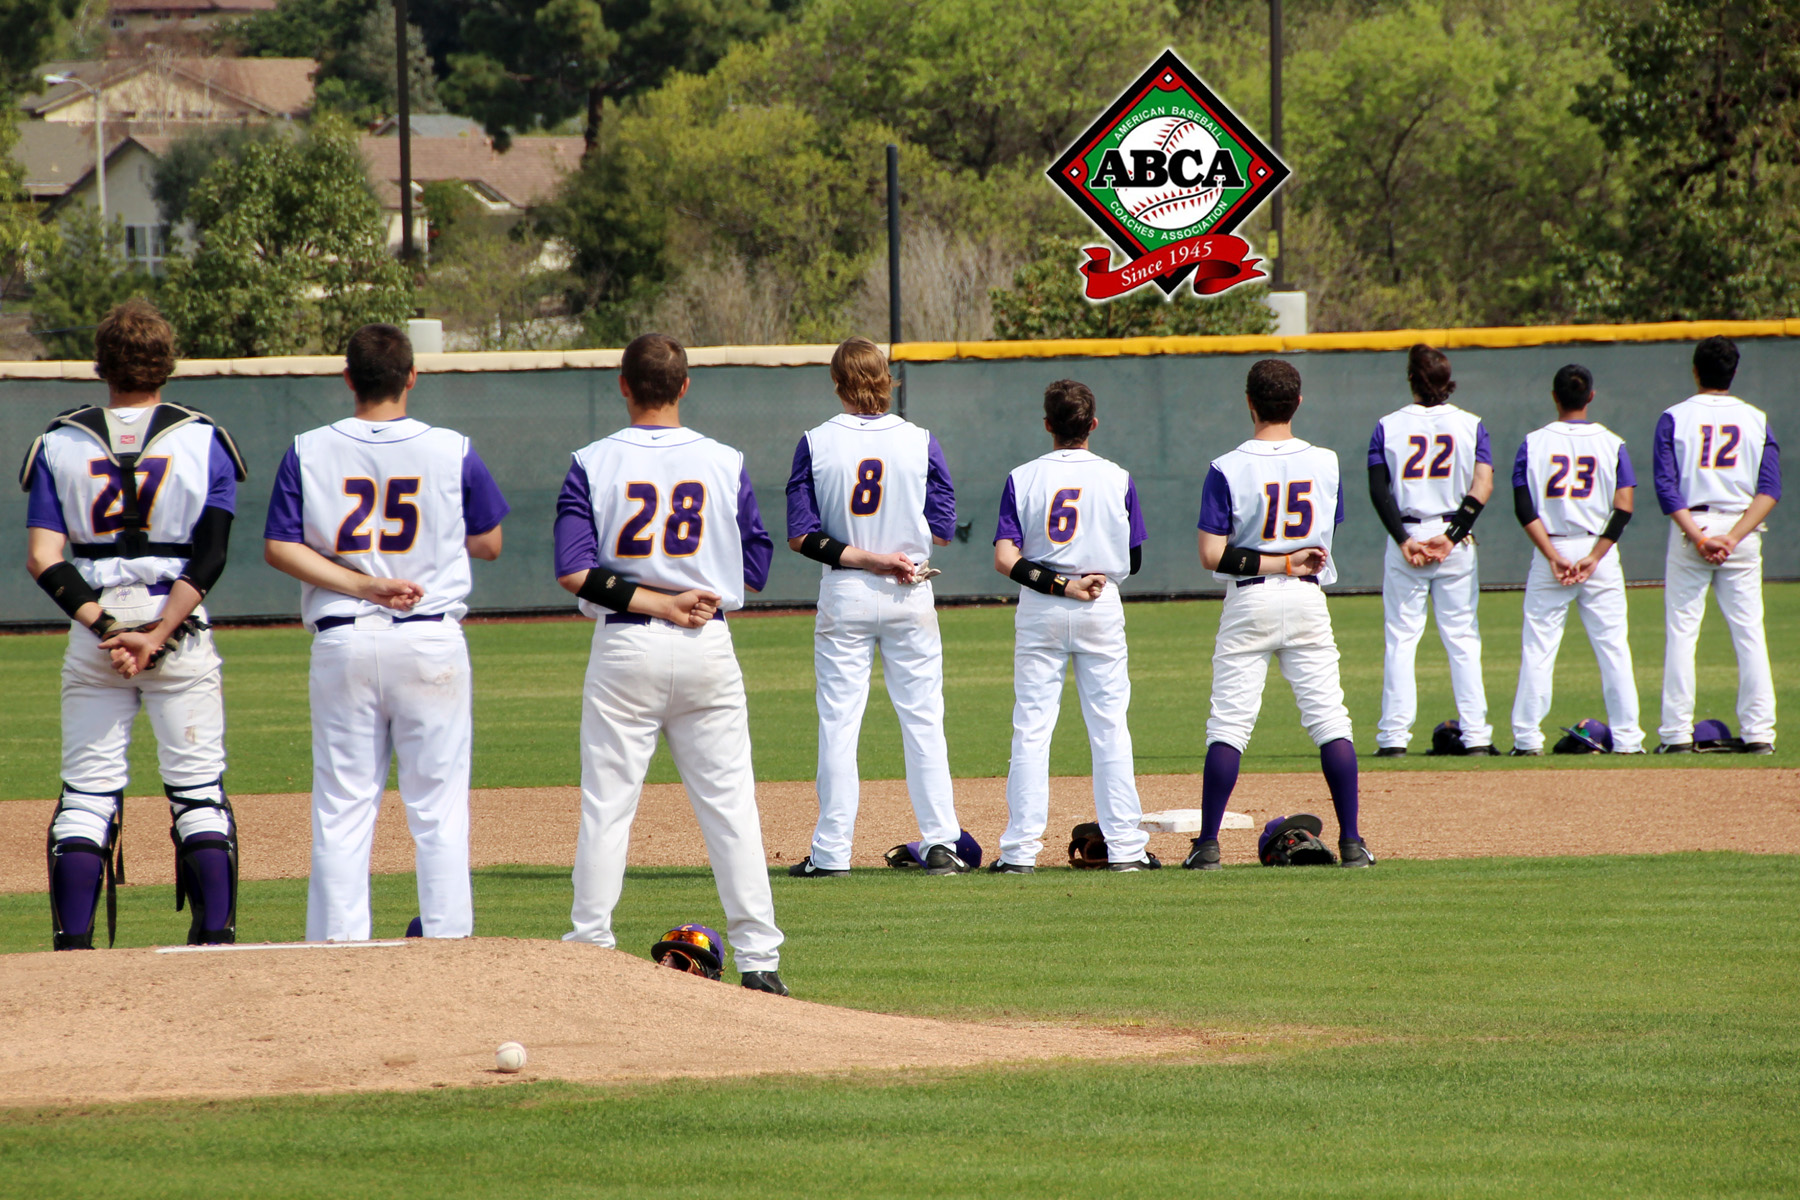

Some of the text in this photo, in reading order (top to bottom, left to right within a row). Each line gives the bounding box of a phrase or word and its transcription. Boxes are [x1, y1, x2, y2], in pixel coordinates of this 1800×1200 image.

[1402, 434, 1454, 480] 22
[1546, 454, 1596, 499] 23
[1699, 424, 1740, 470] 12
[88, 455, 173, 536] 27
[335, 476, 422, 554] 25
[850, 457, 884, 517] 8
[1046, 487, 1082, 545] 6
[1261, 479, 1313, 541] 15
[615, 480, 707, 558] 28
